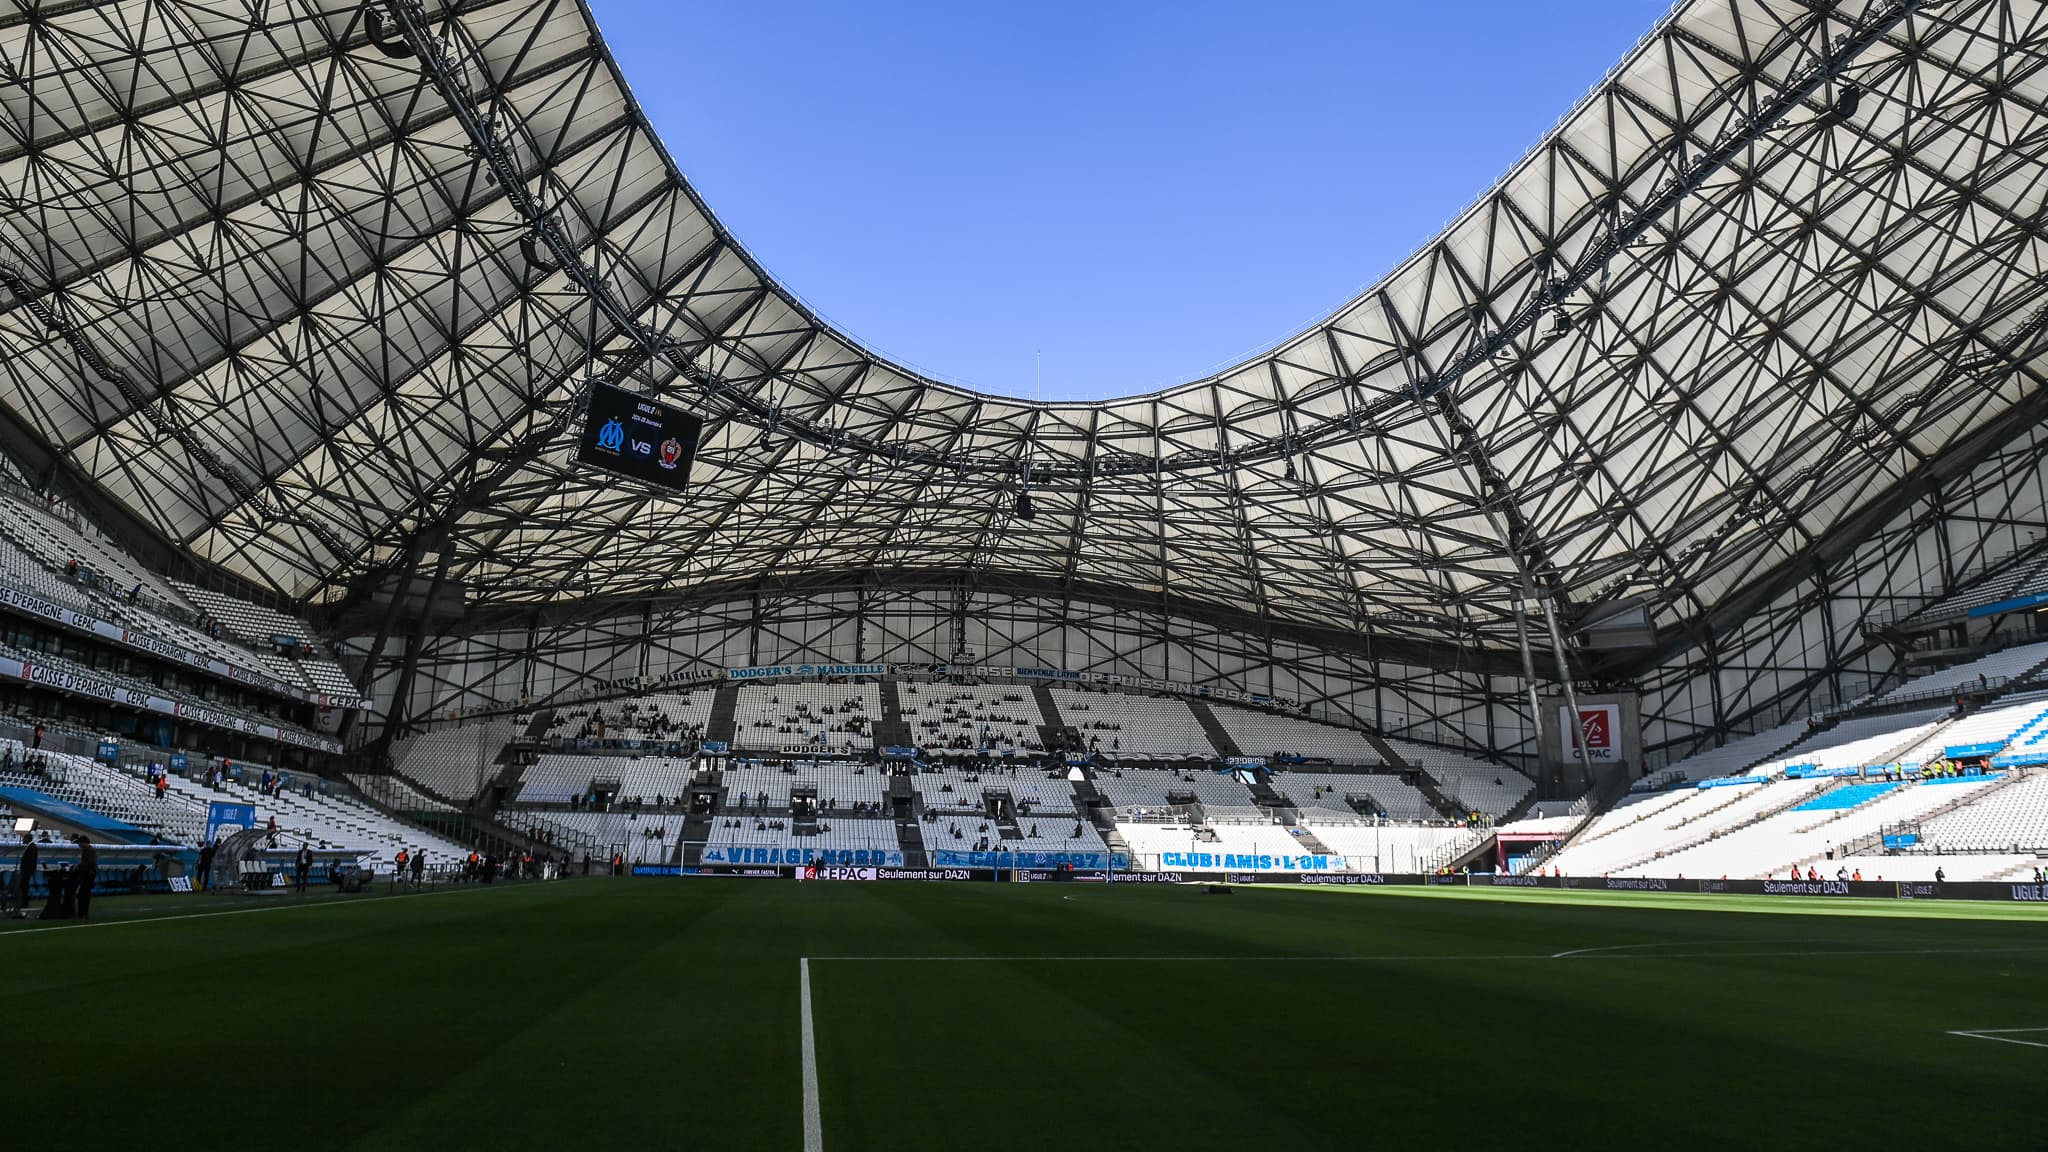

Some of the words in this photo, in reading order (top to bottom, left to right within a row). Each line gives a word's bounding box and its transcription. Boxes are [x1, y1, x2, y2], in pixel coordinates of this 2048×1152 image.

[631, 438, 651, 455] VS
[12, 592, 63, 620] D'EPARGNE
[72, 613, 97, 631] CEPAC
[128, 633, 151, 649] CAISSE
[151, 641, 187, 661] D'EPARGNE
[193, 655, 211, 669] CEPAC
[731, 666, 792, 679] DODGER'S
[817, 665, 884, 675] MARSEILLE
[31, 667, 65, 687] CAISSE
[65, 676, 117, 700] D'EPARGNE
[126, 690, 151, 708] CEPAC
[329, 696, 365, 709] CEPAC
[179, 705, 201, 720] CAISSE
[243, 721, 260, 735] CEPAC
[1573, 749, 1612, 759] CPAC
[727, 848, 814, 865] VIRAGE
[822, 849, 886, 865] NORD
[1163, 852, 1213, 867] CLUB
[1224, 854, 1271, 869] AMIS
[819, 868, 868, 880] CEPAC
[878, 869, 927, 879] Seulement
[928, 871, 943, 879] sur
[945, 870, 970, 880] DAZN
[1094, 872, 1141, 881] Slement
[1142, 873, 1156, 882] sur
[1158, 872, 1182, 882] DAZN
[1300, 874, 1345, 883] Seulement
[1360, 874, 1384, 883] DAZN
[1607, 879, 1638, 889] Seulement
[1639, 881, 1649, 889] sur
[1650, 879, 1667, 890] DAZN
[1764, 881, 1808, 893] Seulement
[1809, 884, 1823, 893] sur
[1823, 882, 1849, 894] DAZN
[2012, 885, 2041, 900] LIGUE
